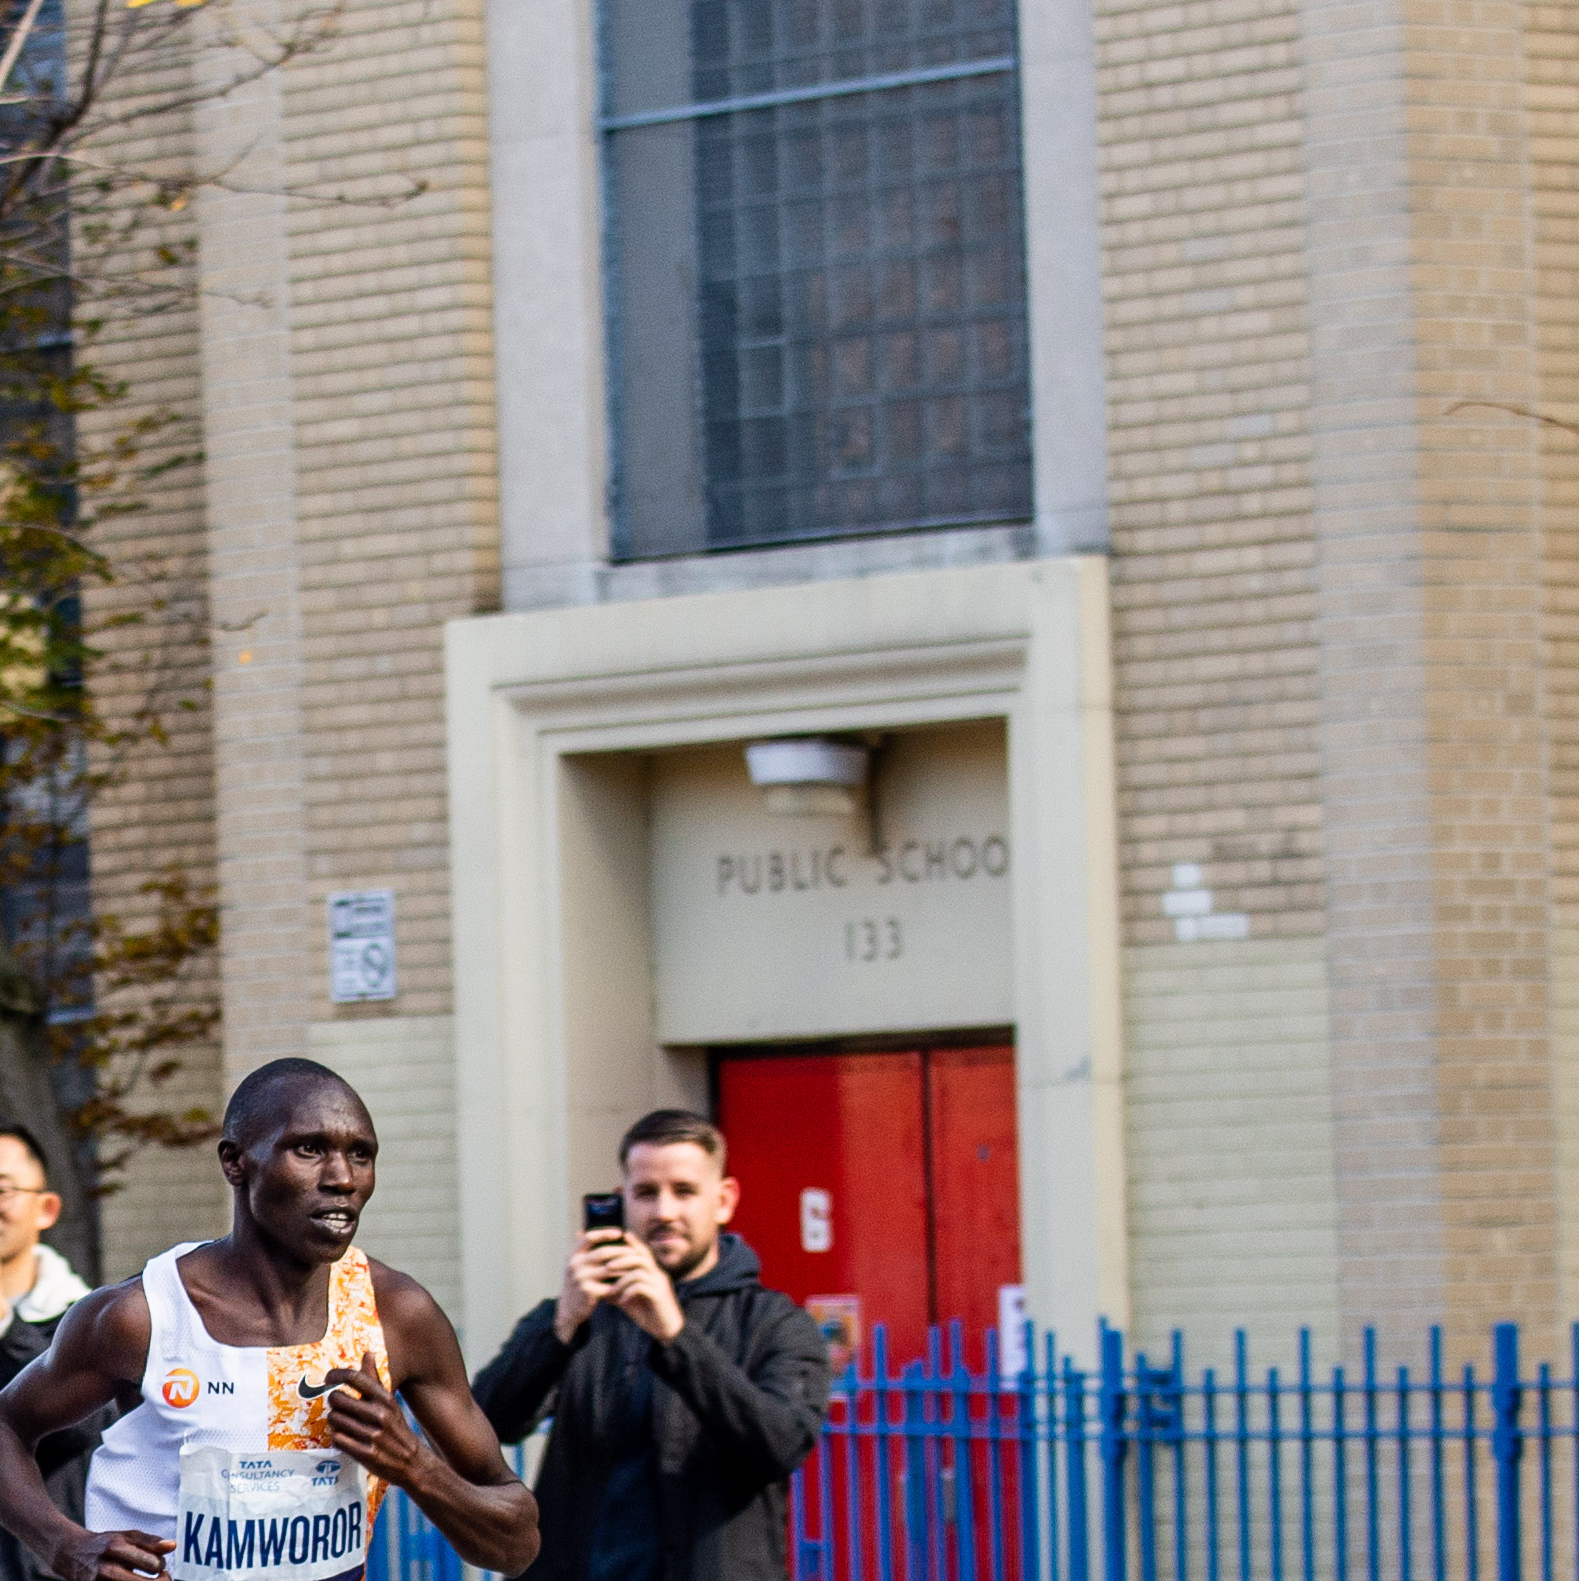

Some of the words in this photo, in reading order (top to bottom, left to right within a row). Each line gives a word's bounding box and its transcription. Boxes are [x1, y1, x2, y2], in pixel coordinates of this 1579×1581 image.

[716, 847, 847, 893] PUBLIC
[865, 836, 1009, 886] SCHOO
[845, 918, 903, 962] 133
[208, 1381, 234, 1394] NN
[239, 1460, 272, 1469] TATA
[183, 1501, 361, 1570] KAMWOROR
